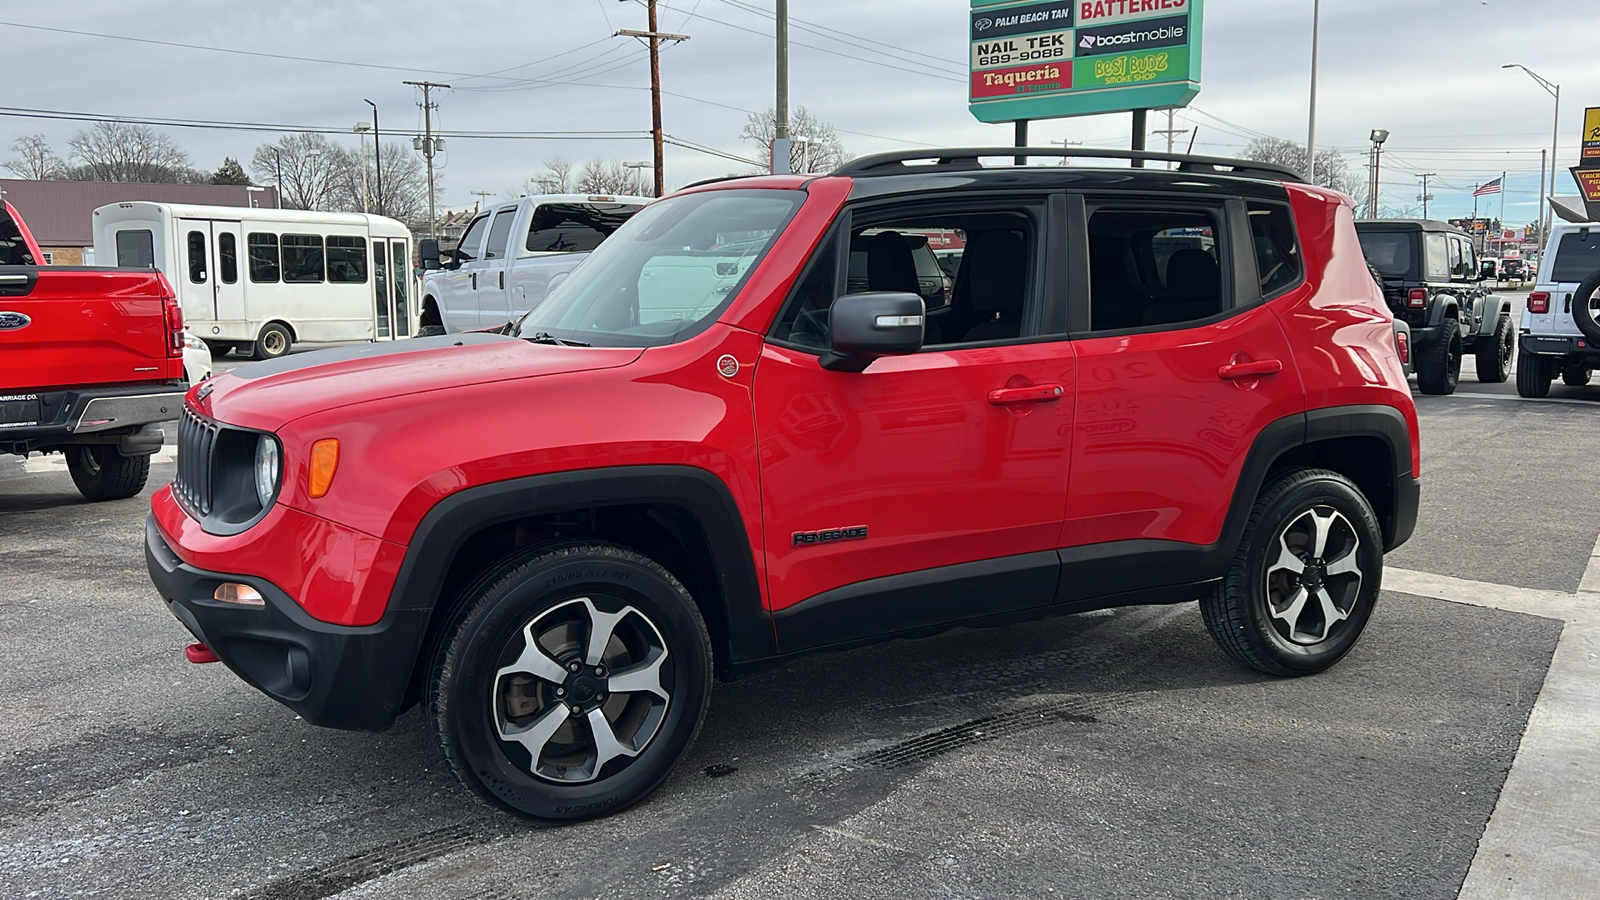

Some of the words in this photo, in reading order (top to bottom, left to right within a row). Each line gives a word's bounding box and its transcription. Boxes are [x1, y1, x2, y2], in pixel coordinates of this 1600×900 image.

[995, 16, 1019, 28] PALM
[1020, 12, 1049, 25] BEACH
[1051, 8, 1069, 20] TAN
[977, 40, 1018, 56] NAIL
[1026, 33, 1065, 49] TEK
[979, 47, 1064, 66] 689-9088
[1129, 52, 1168, 75] BUDZ
[1104, 74, 1132, 85] SMOKE
[1133, 72, 1156, 82] SHOP
[791, 524, 869, 547] RENEGADE
